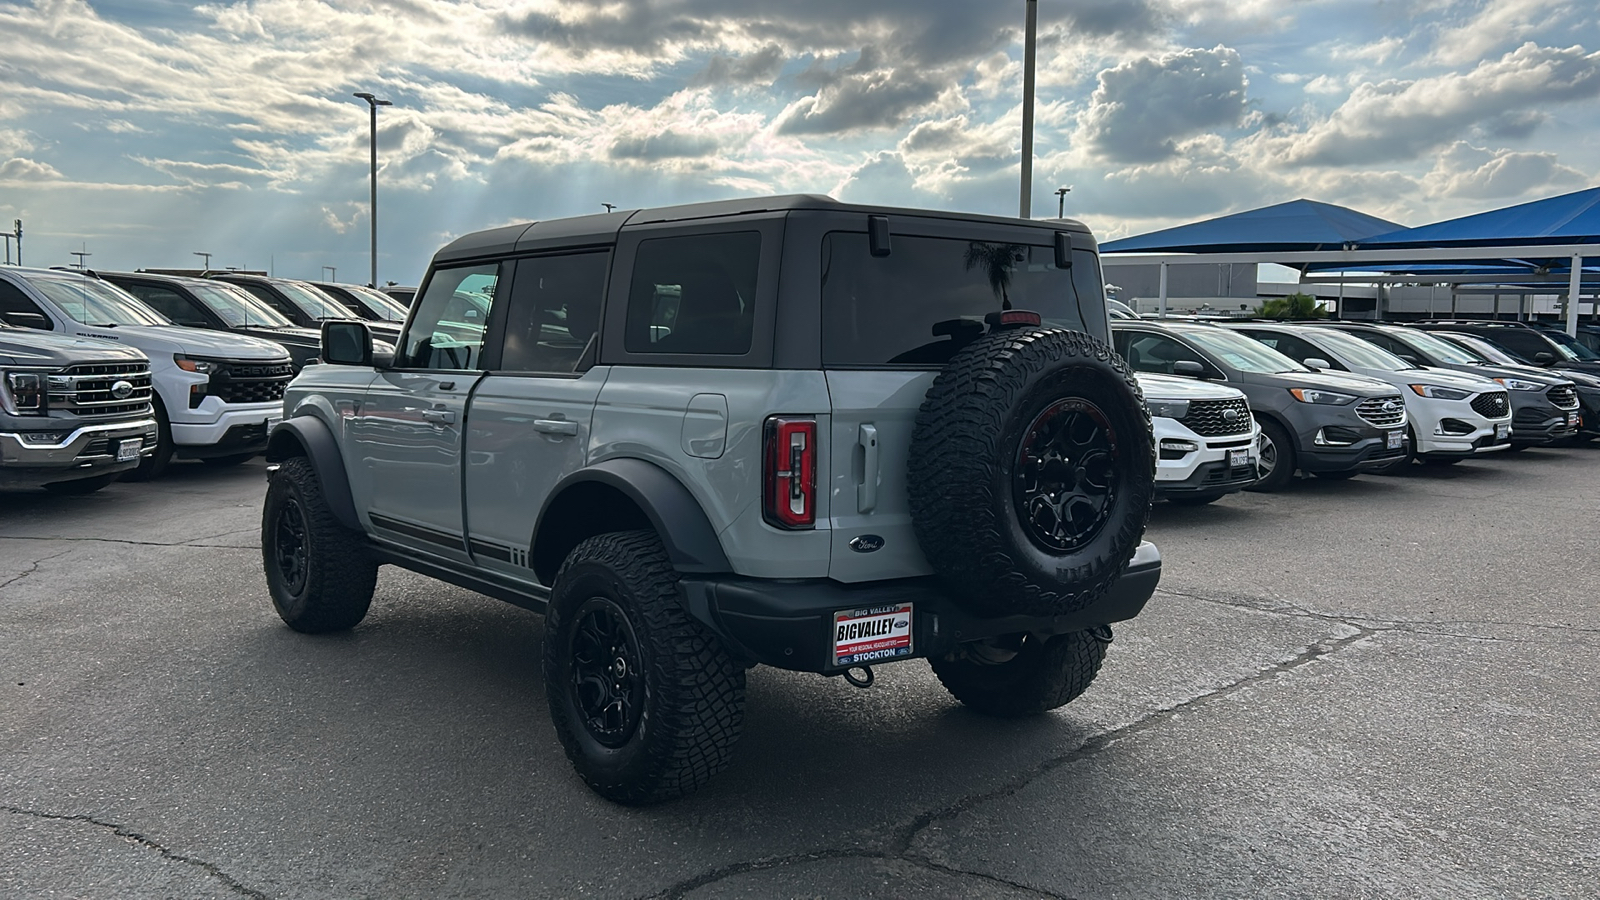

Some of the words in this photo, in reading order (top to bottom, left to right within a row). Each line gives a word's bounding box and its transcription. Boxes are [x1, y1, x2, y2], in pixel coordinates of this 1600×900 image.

[858, 539, 878, 550] Ford
[854, 609, 868, 617] BIG
[870, 606, 896, 615] VALLEY
[853, 648, 896, 662] STOCKTON
